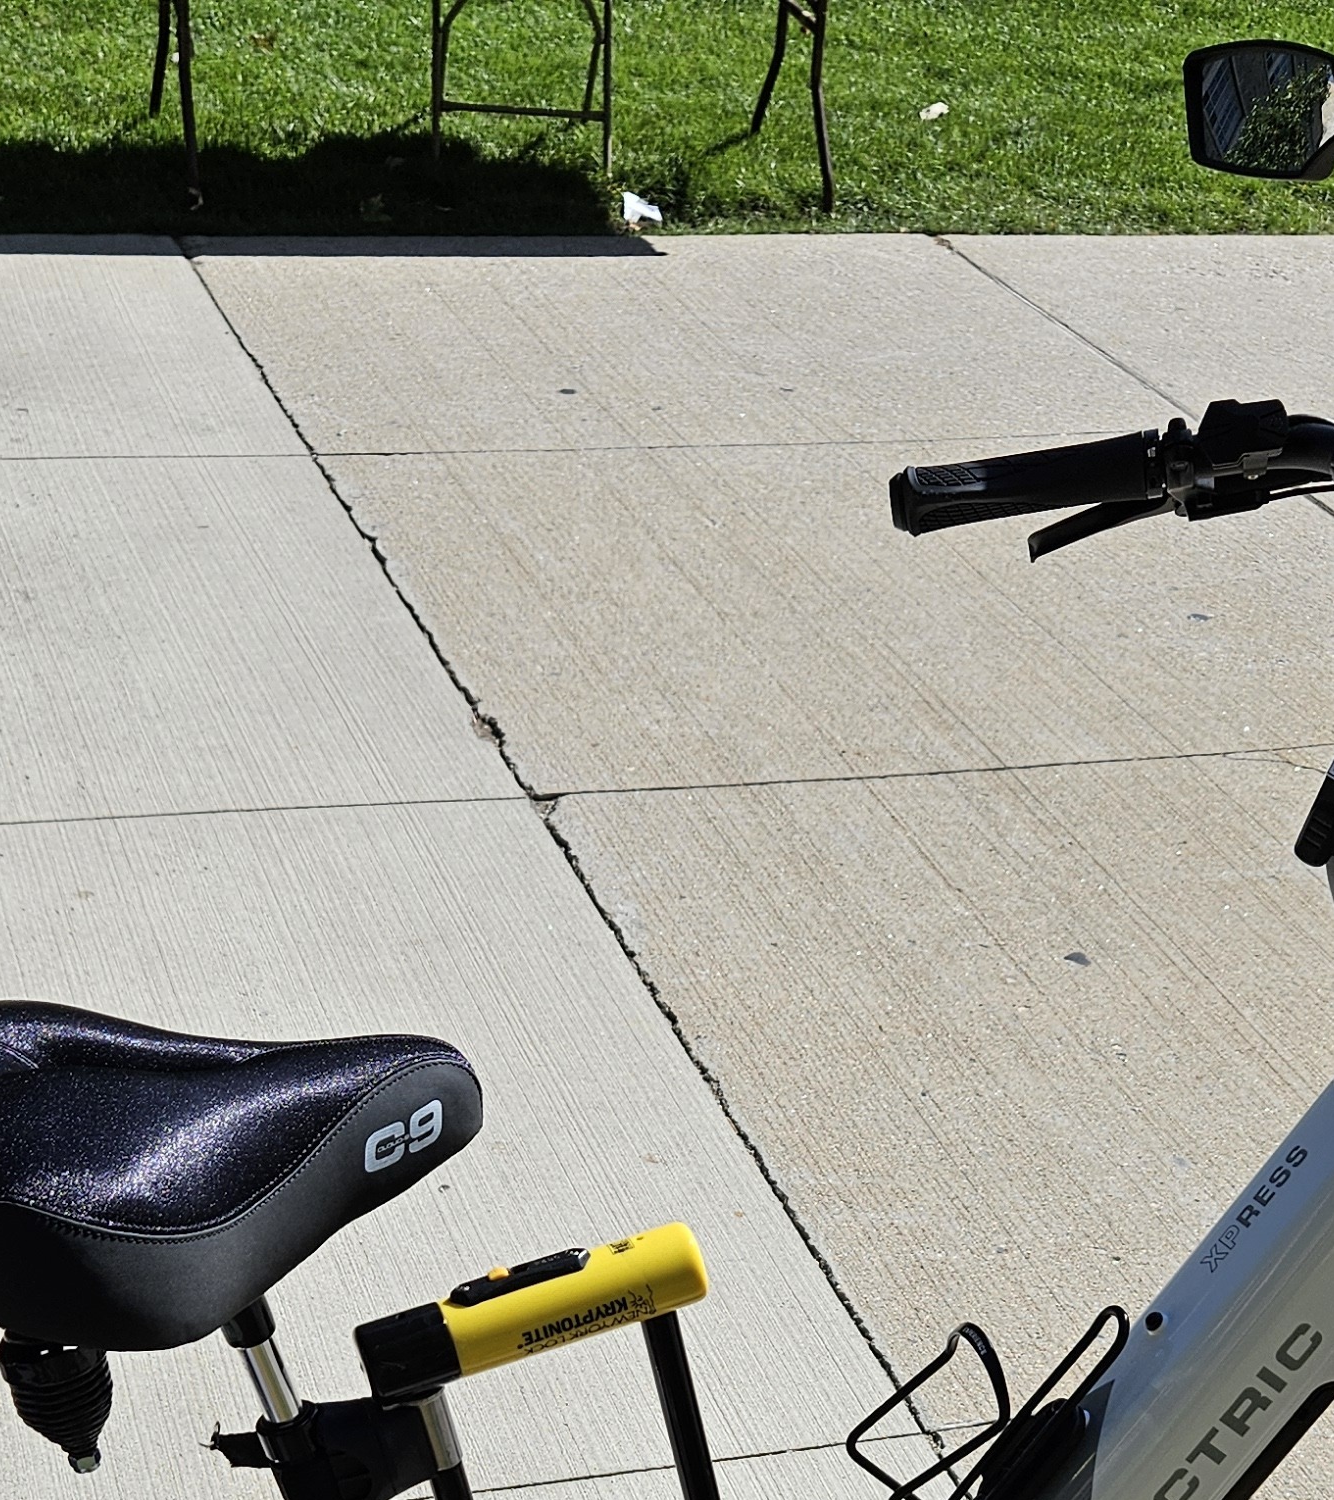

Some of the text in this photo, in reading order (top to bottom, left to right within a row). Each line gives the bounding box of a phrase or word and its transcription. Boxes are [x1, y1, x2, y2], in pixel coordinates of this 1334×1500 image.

[364, 1098, 443, 1173] C9
[1200, 1144, 1308, 1273] XPRESS
[521, 1296, 629, 1346] KRYPTONITE
[525, 1335, 567, 1354] LOCK
